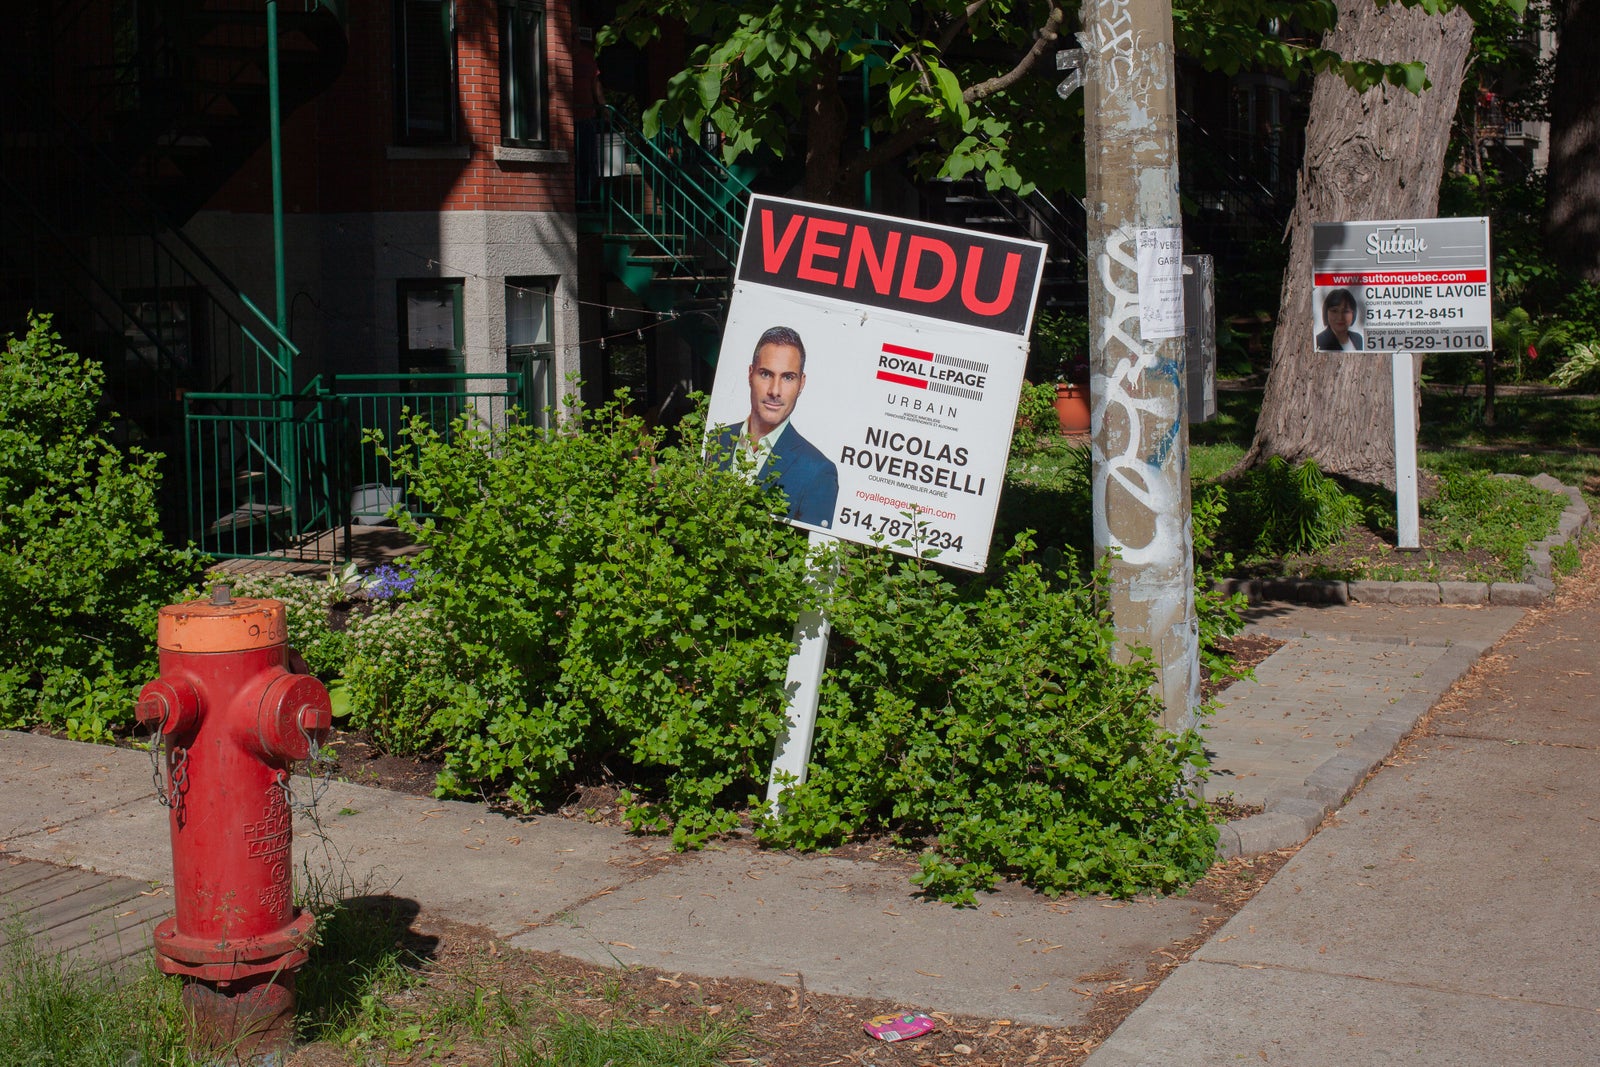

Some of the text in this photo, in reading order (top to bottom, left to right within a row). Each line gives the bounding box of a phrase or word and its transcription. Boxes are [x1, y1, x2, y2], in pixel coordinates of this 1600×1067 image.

[1366, 233, 1428, 255] Sutton
[761, 209, 1022, 316] VENDU
[1333, 272, 1467, 284] www.suttonquebec.com
[1365, 284, 1487, 300] CLAUDINE LAVOIE
[1366, 307, 1464, 320] 514-712-8451
[1367, 334, 1485, 349] 514-529-1010
[878, 355, 926, 376] ROYAL
[887, 393, 957, 418] URBAIN
[865, 426, 969, 466] NICOLAS
[840, 445, 985, 496] ROVERSELLI
[868, 475, 896, 486] COURTIER
[896, 481, 928, 494] IMMOBILIER
[839, 507, 963, 552] 514.787.1234
